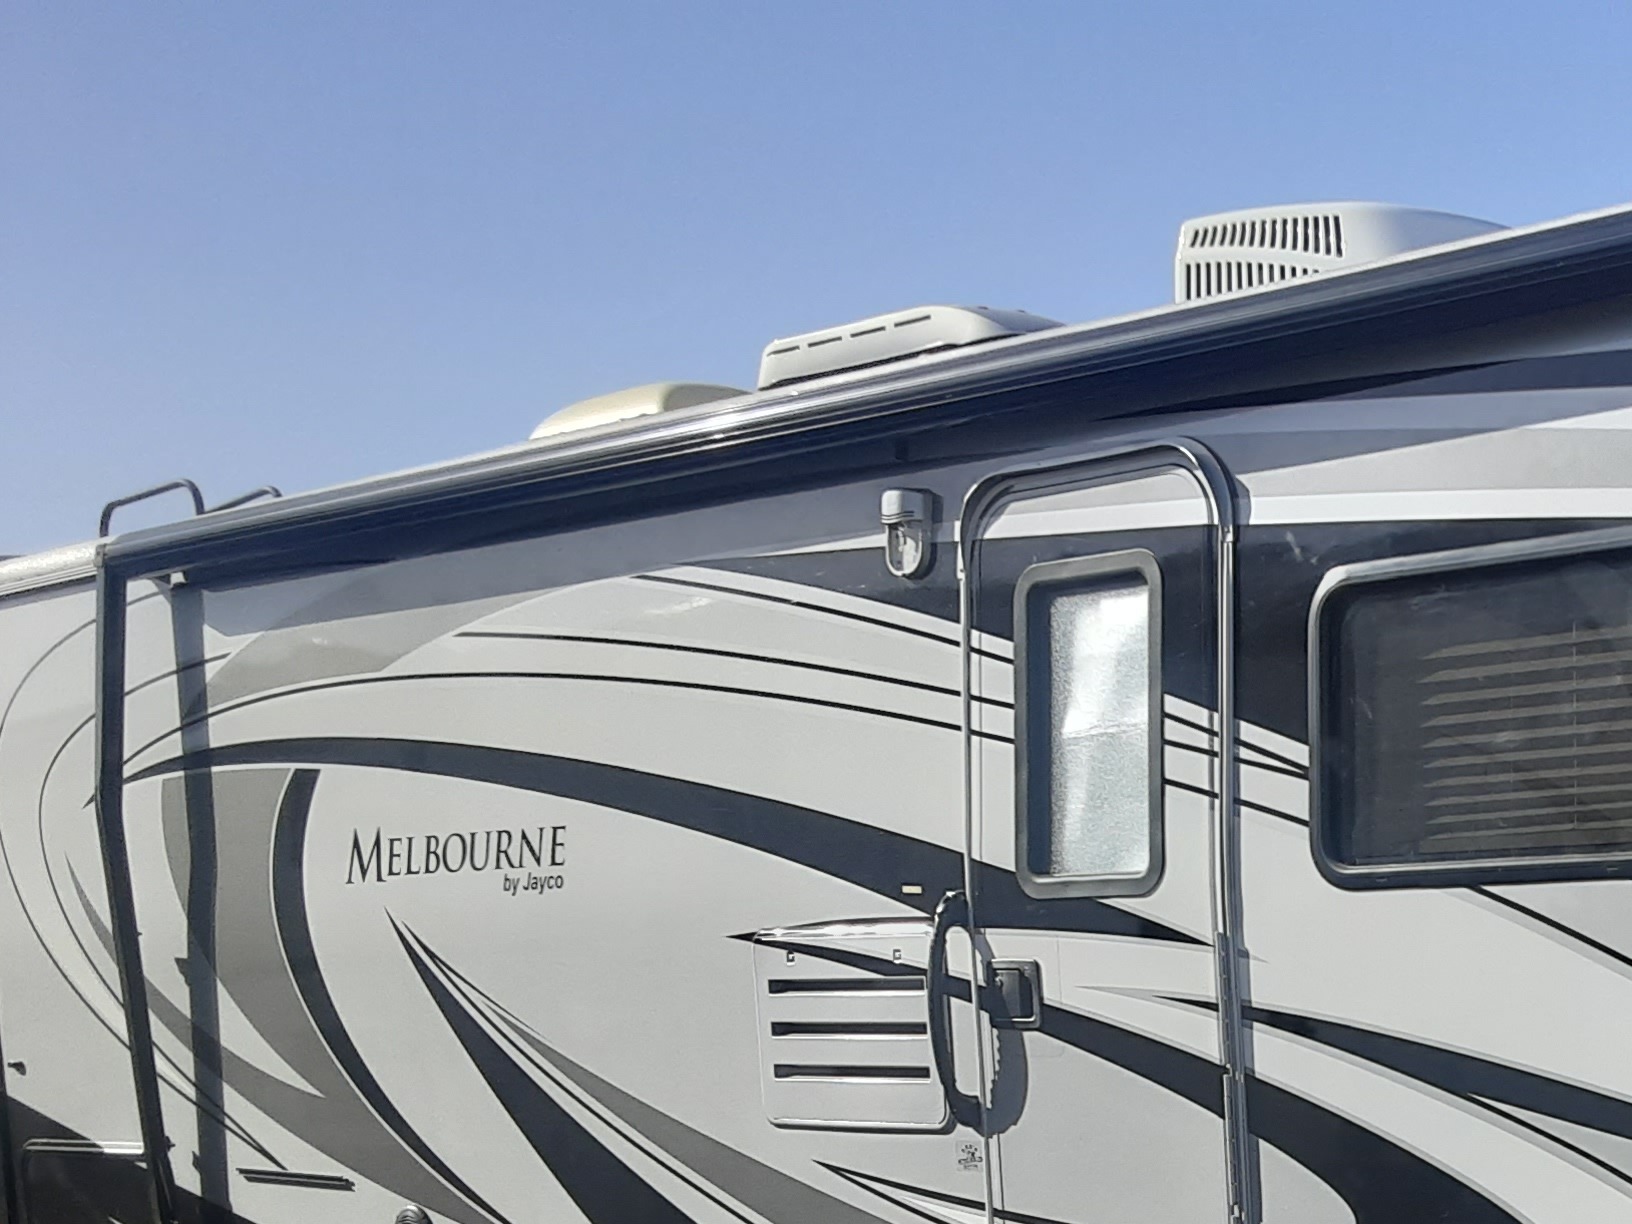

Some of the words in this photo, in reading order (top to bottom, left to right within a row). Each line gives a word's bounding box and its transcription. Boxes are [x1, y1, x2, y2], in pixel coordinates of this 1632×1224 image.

[346, 826, 566, 884] MELBOURNE
[503, 873, 520, 896] by
[522, 872, 564, 895] Jayco
